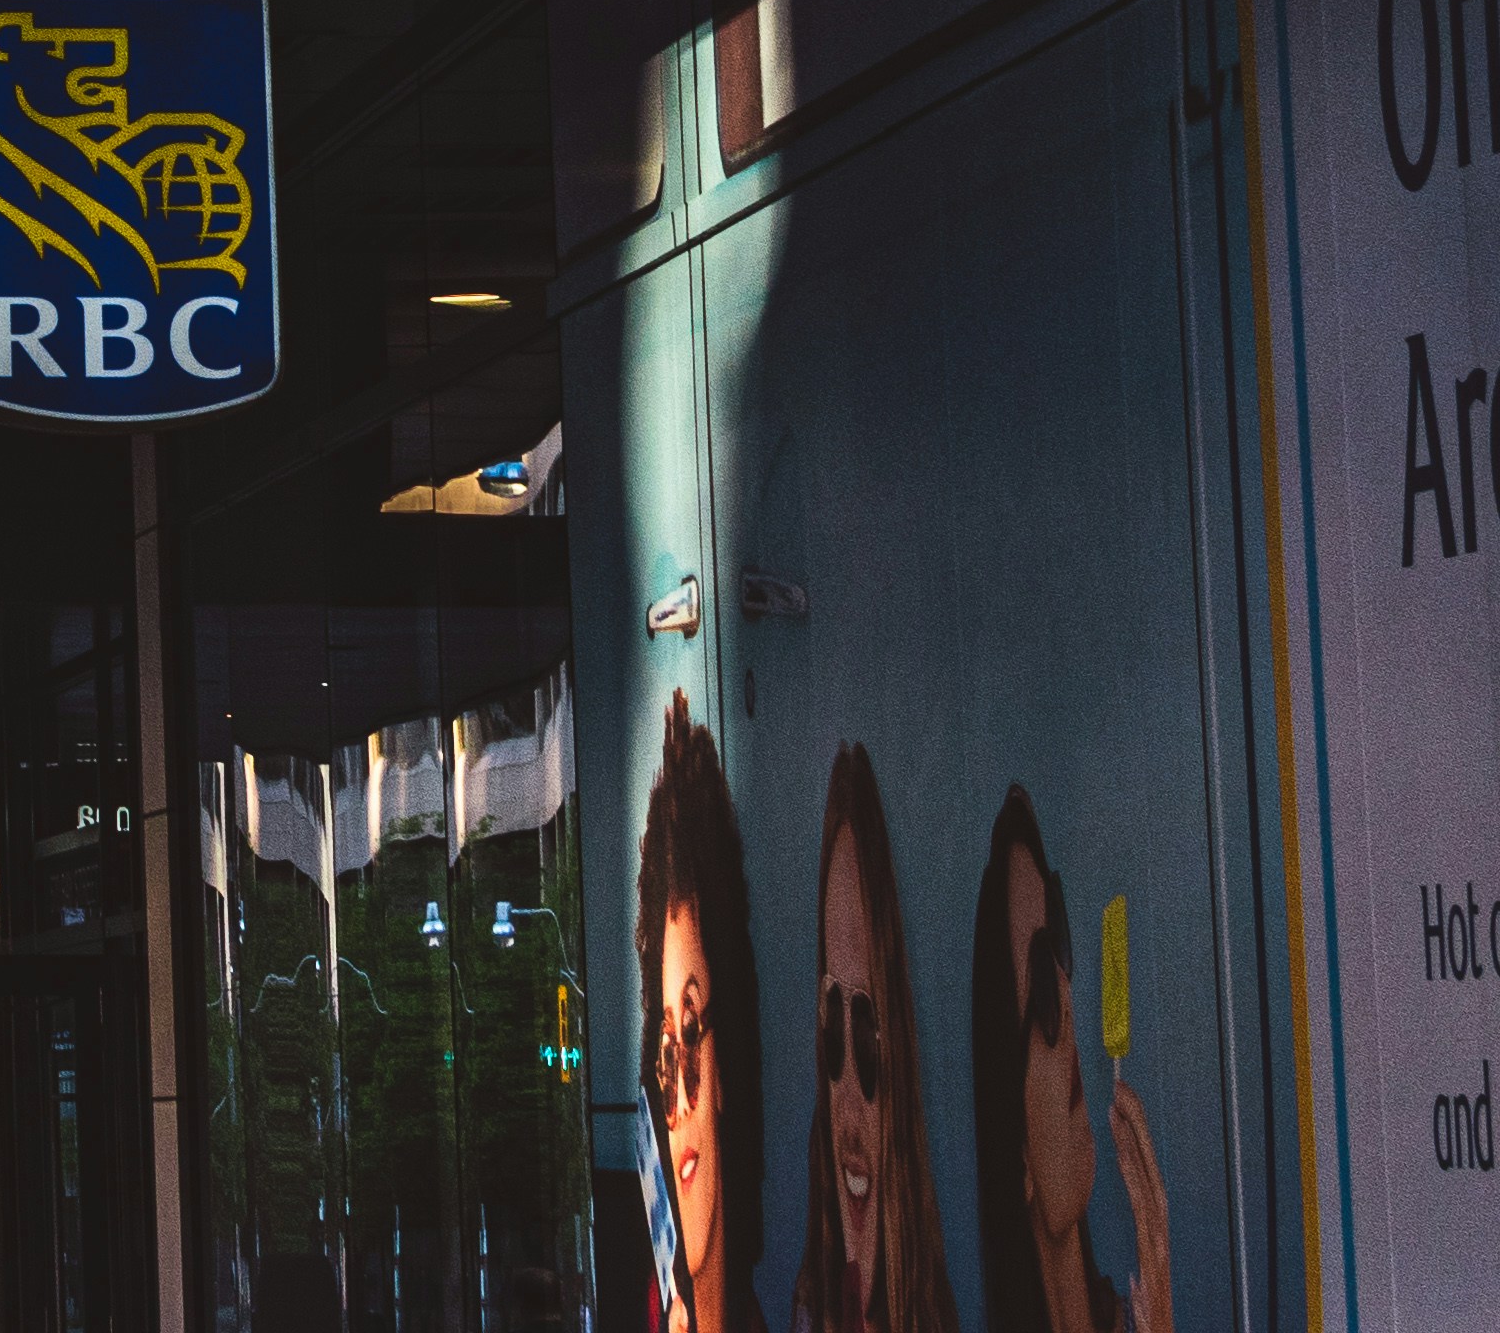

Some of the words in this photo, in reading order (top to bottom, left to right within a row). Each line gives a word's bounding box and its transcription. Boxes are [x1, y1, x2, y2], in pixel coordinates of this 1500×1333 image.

[1401, 331, 1500, 568] Ar
[1419, 881, 1484, 981] Hot
[1433, 1059, 1496, 1172] and
